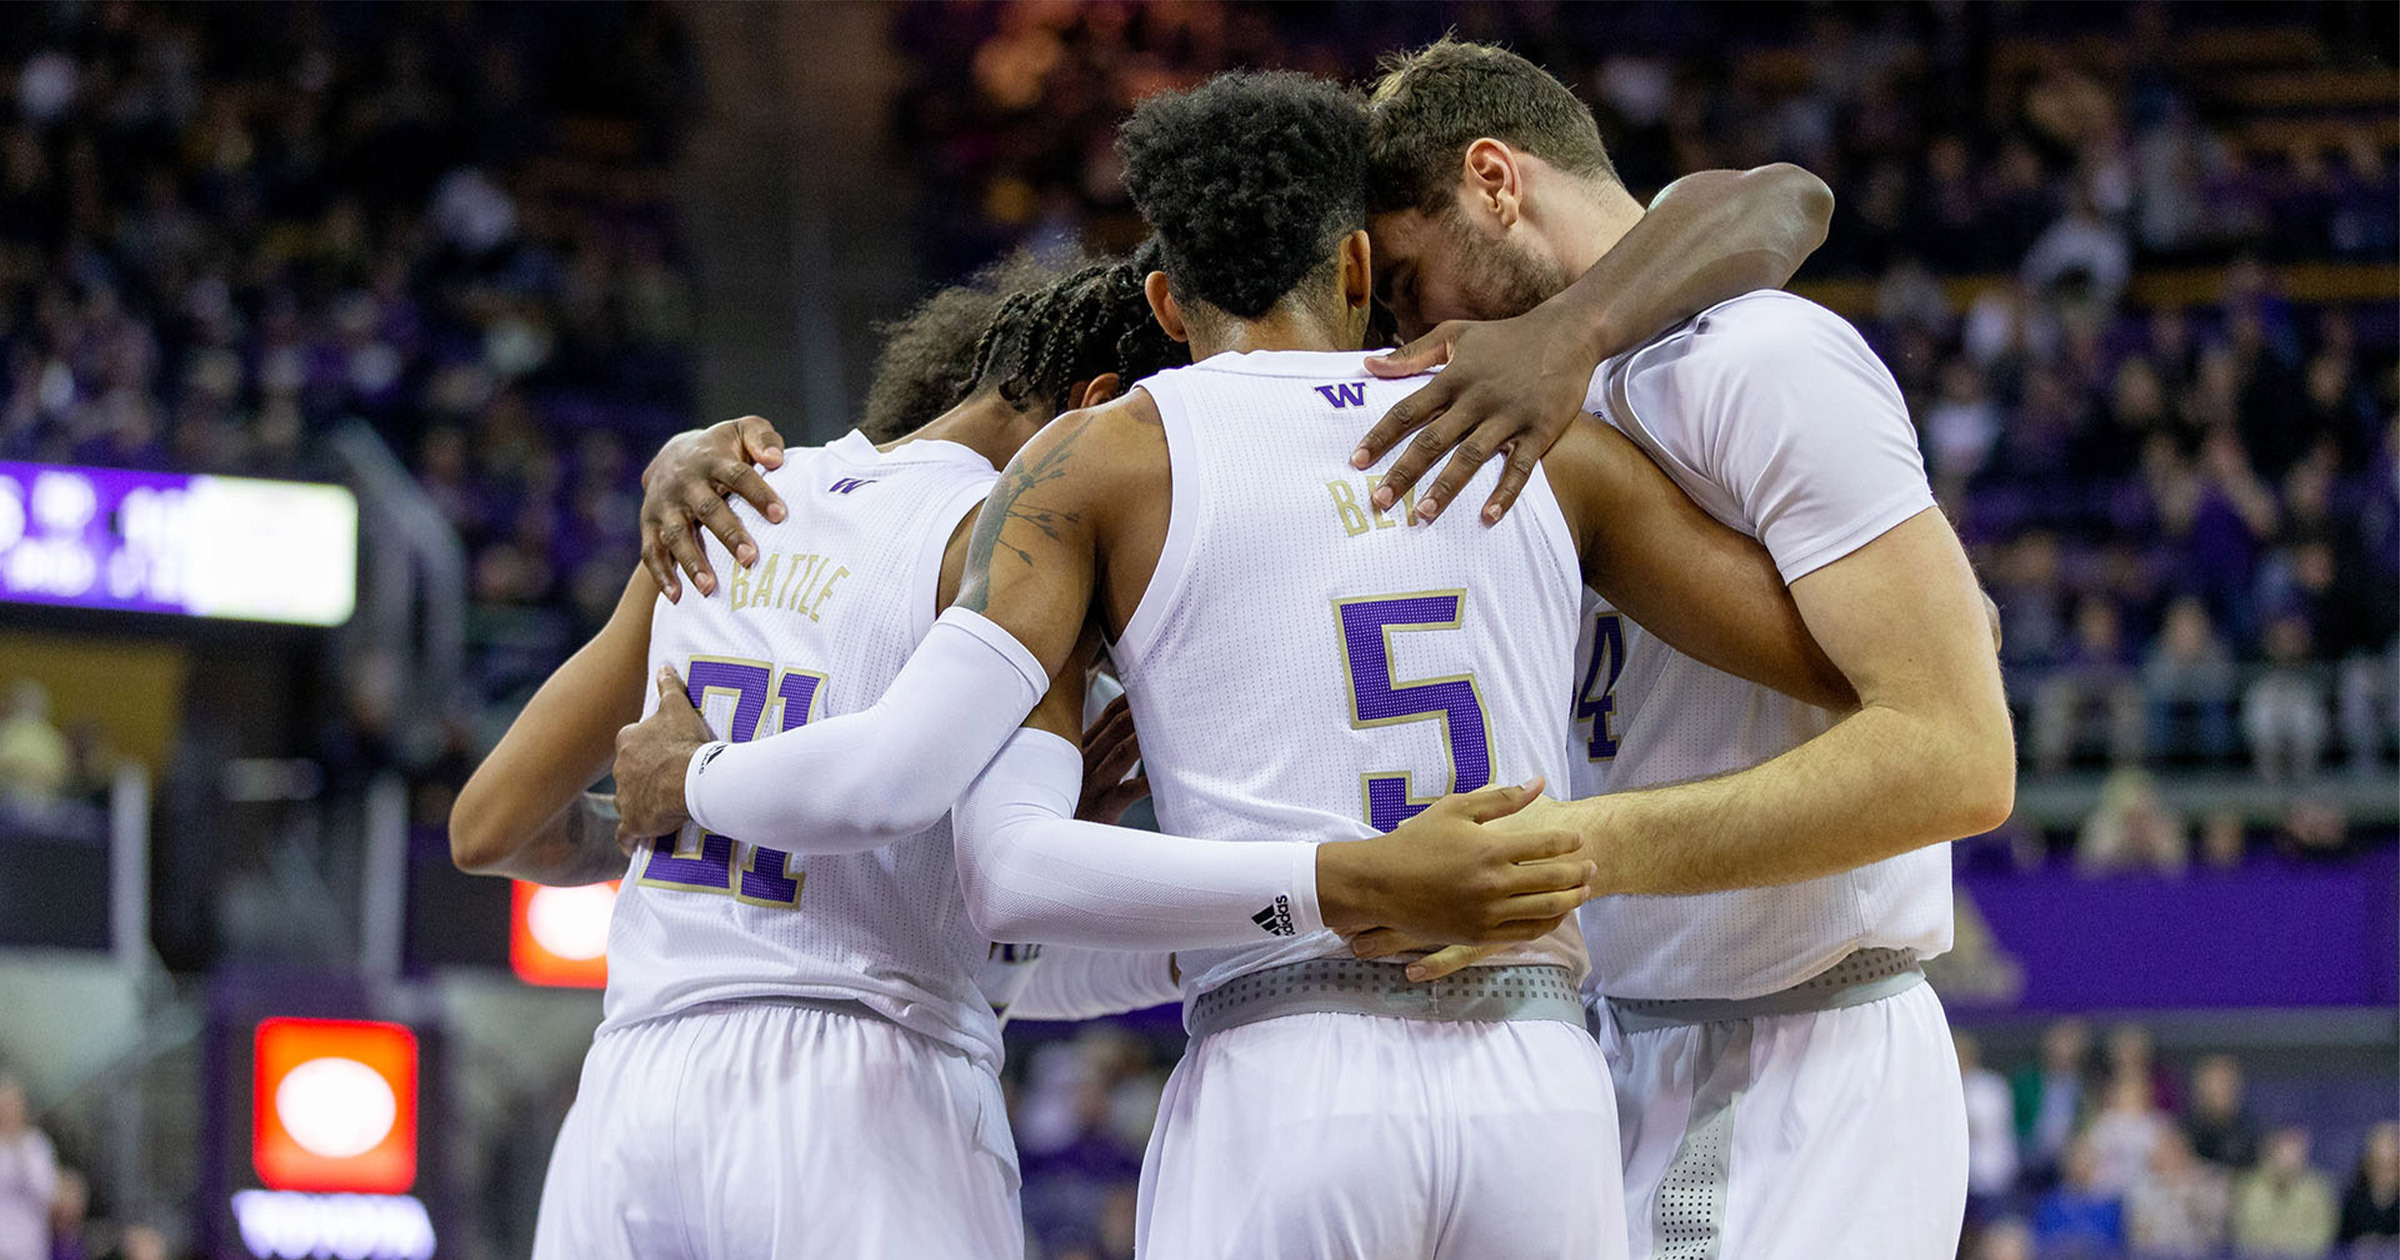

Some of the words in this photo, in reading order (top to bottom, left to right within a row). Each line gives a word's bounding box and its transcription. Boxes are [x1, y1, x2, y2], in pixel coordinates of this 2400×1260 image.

[1313, 381, 1367, 410] W
[730, 553, 850, 623] BATTLE
[1331, 587, 1497, 832] 5
[1569, 611, 1627, 763] 4
[636, 654, 829, 912] 21
[1275, 894, 1296, 936] didas
